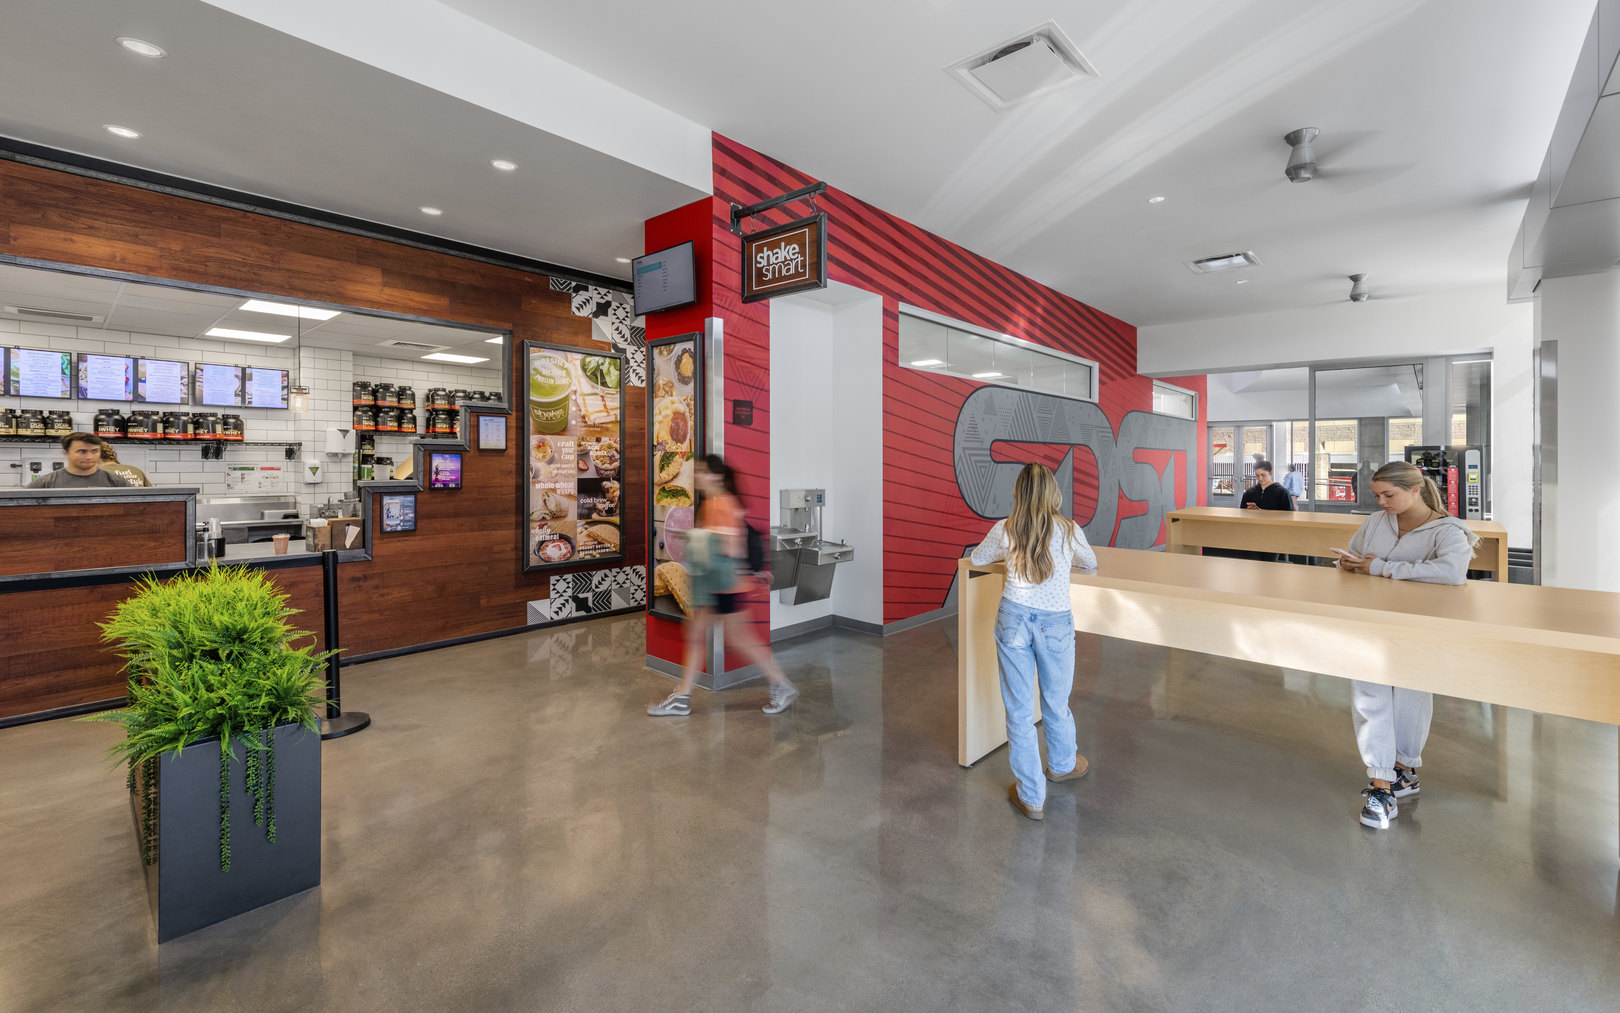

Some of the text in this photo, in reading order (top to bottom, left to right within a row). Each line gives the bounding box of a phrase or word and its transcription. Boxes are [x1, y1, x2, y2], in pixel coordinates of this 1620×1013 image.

[756, 242, 800, 268] shake
[762, 253, 804, 280] smart
[598, 501, 615, 511] coffee
